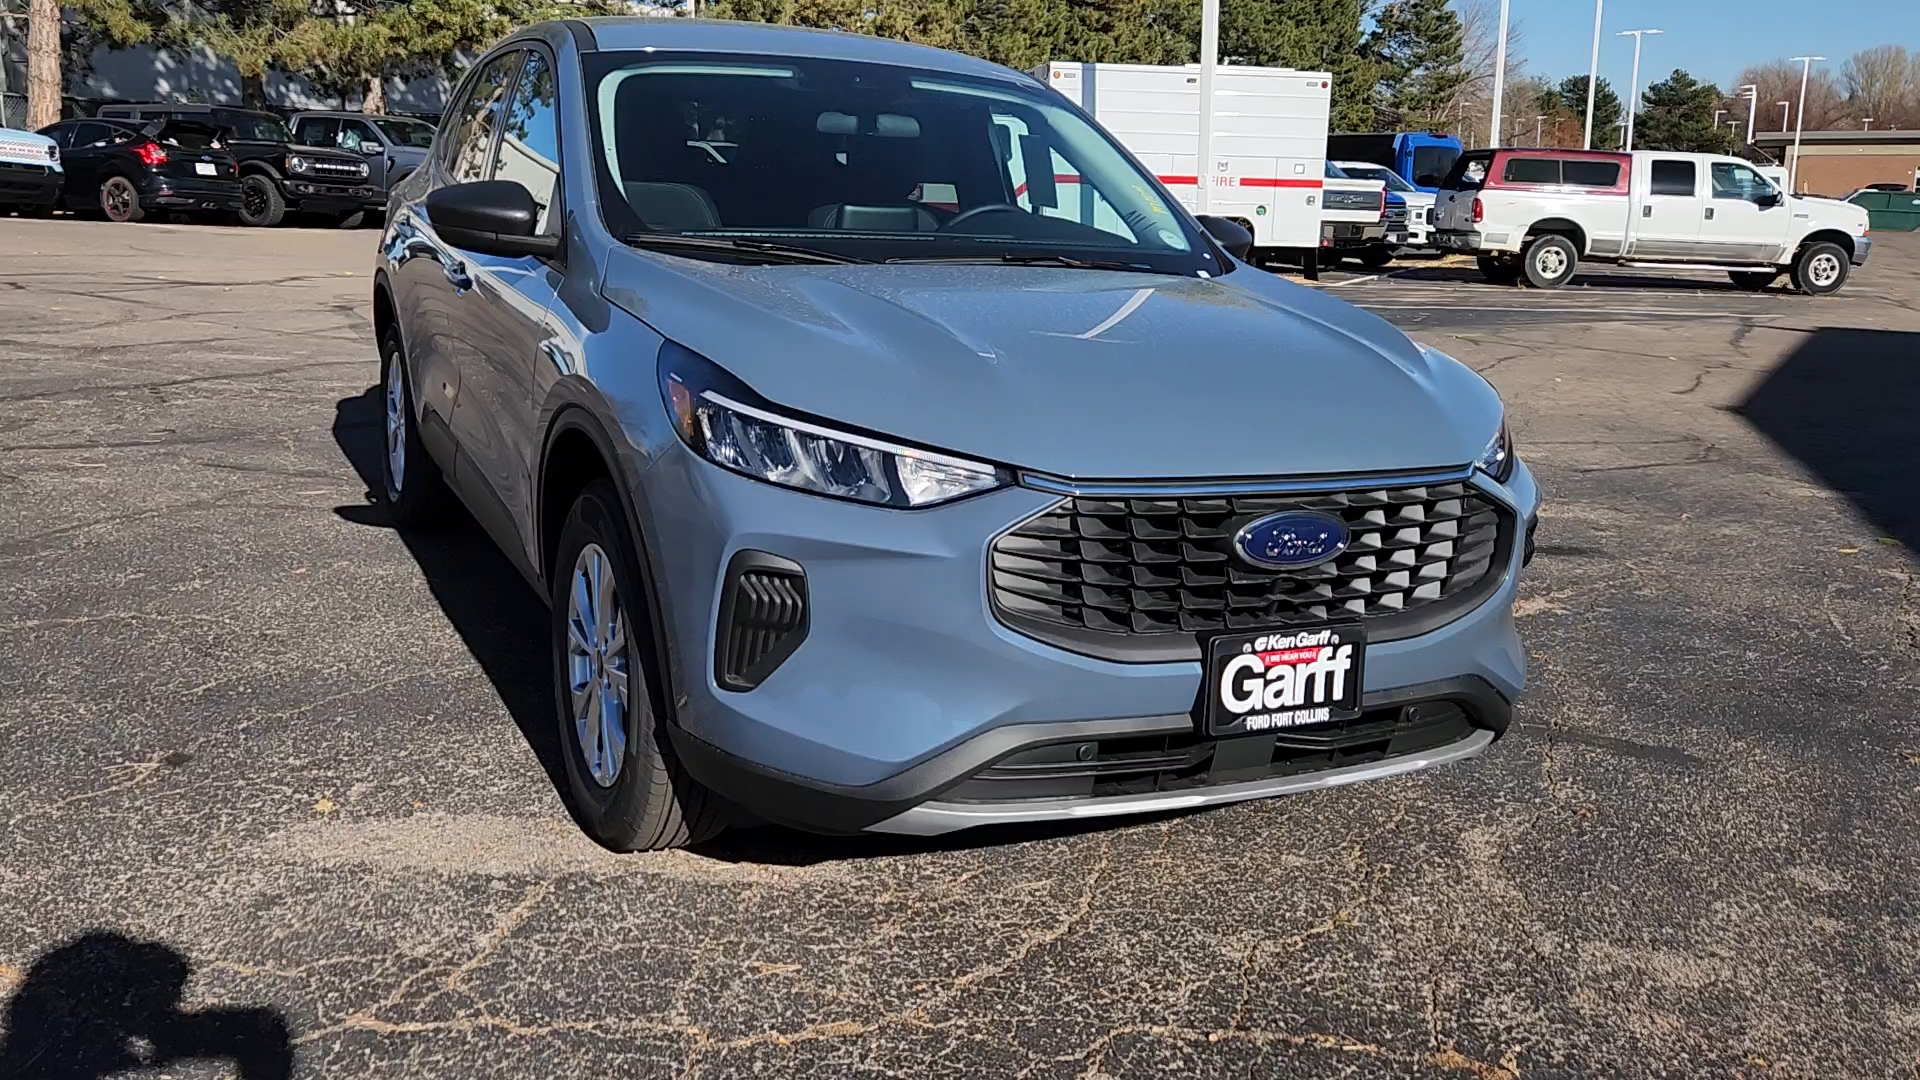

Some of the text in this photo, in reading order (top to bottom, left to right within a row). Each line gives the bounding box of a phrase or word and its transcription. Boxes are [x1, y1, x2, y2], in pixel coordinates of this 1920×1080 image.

[1268, 634, 1295, 650] Ken
[1296, 629, 1331, 647] Garff
[1299, 651, 1312, 660] YOU
[1220, 644, 1353, 714] Garff
[1245, 707, 1330, 731] FORD FORT COLLINS
